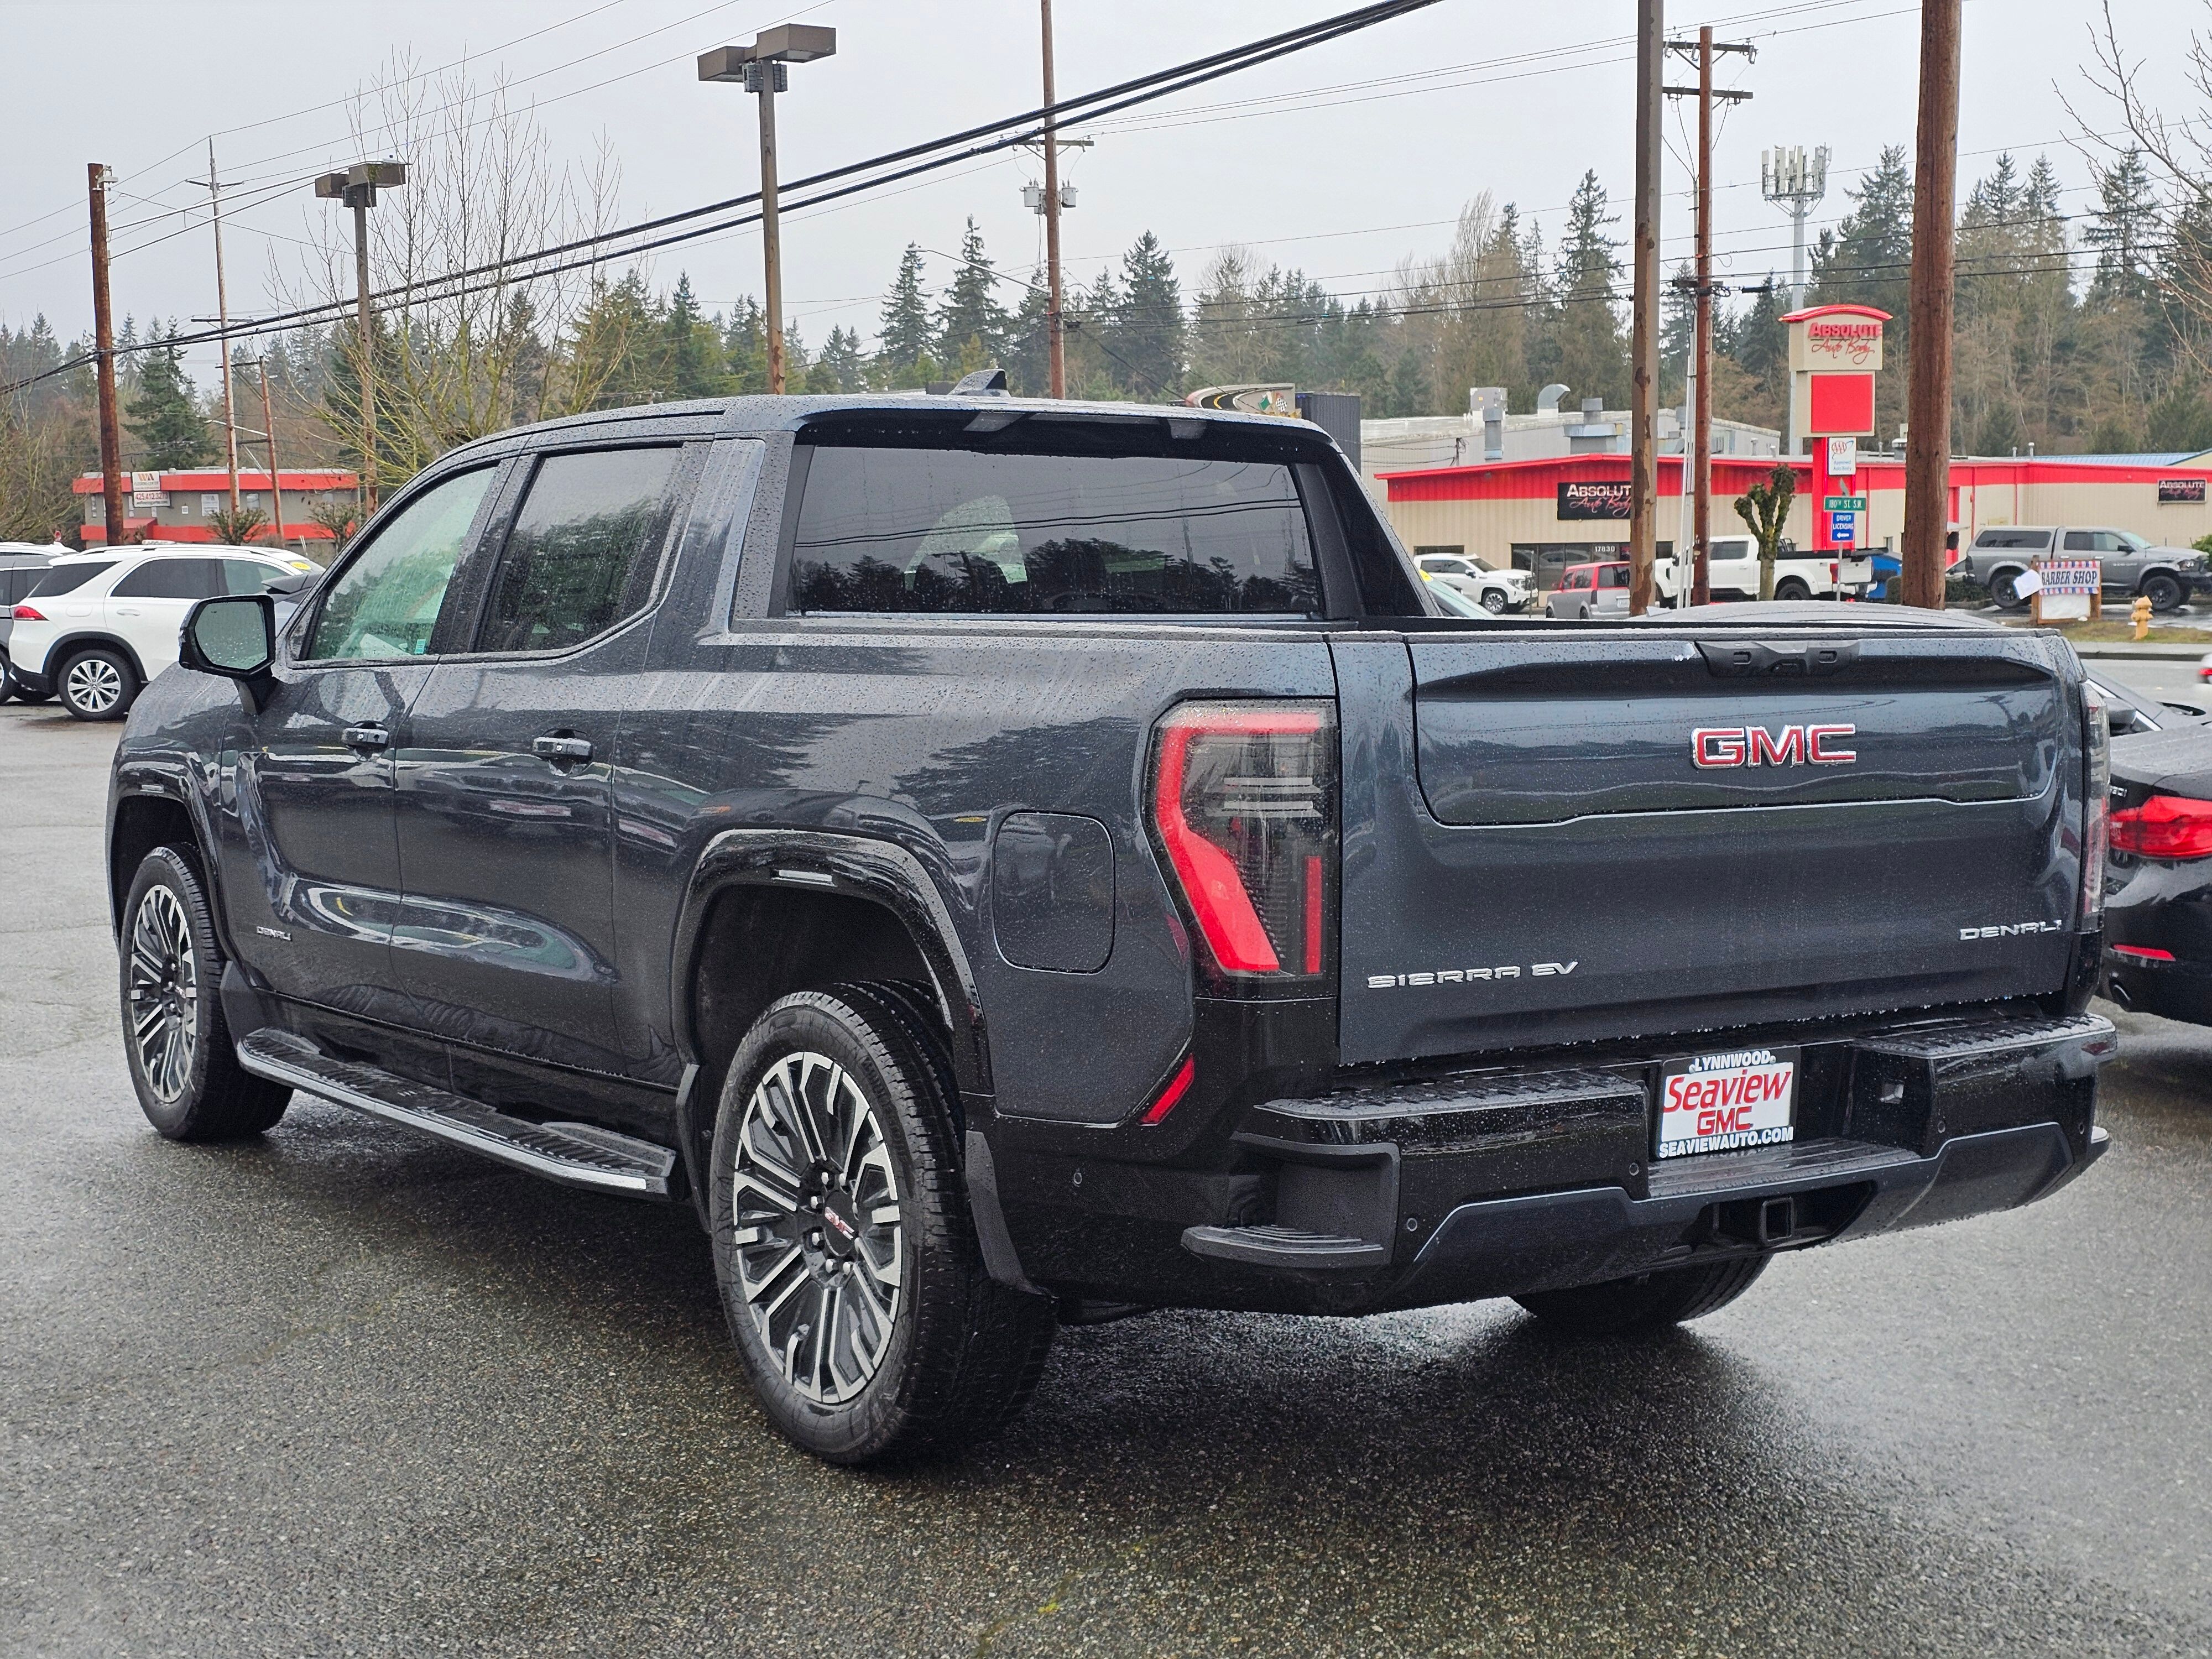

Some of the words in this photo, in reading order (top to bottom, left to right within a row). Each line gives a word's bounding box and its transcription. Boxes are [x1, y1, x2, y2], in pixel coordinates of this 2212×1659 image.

[1808, 322, 1882, 337] ABSOLUTE
[1812, 338, 1843, 358] Auto
[1845, 336, 1875, 364] Body
[1567, 484, 1631, 497] ABSOLUT
[1569, 497, 1602, 513] Auto
[2042, 571, 2070, 585] BARBER
[2073, 571, 2097, 585] SHOP
[1691, 723, 1857, 769] GMC
[1960, 919, 2062, 940] DENALI
[1367, 966, 1521, 988] SIERRA
[1531, 961, 1578, 976] EV
[1695, 1050, 1771, 1072] LYNNWOOD
[1663, 1069, 1791, 1113] Seaview
[1697, 1106, 1752, 1135] GMC
[1659, 1126, 1794, 1158] SEAVIEWAUTO.COM
